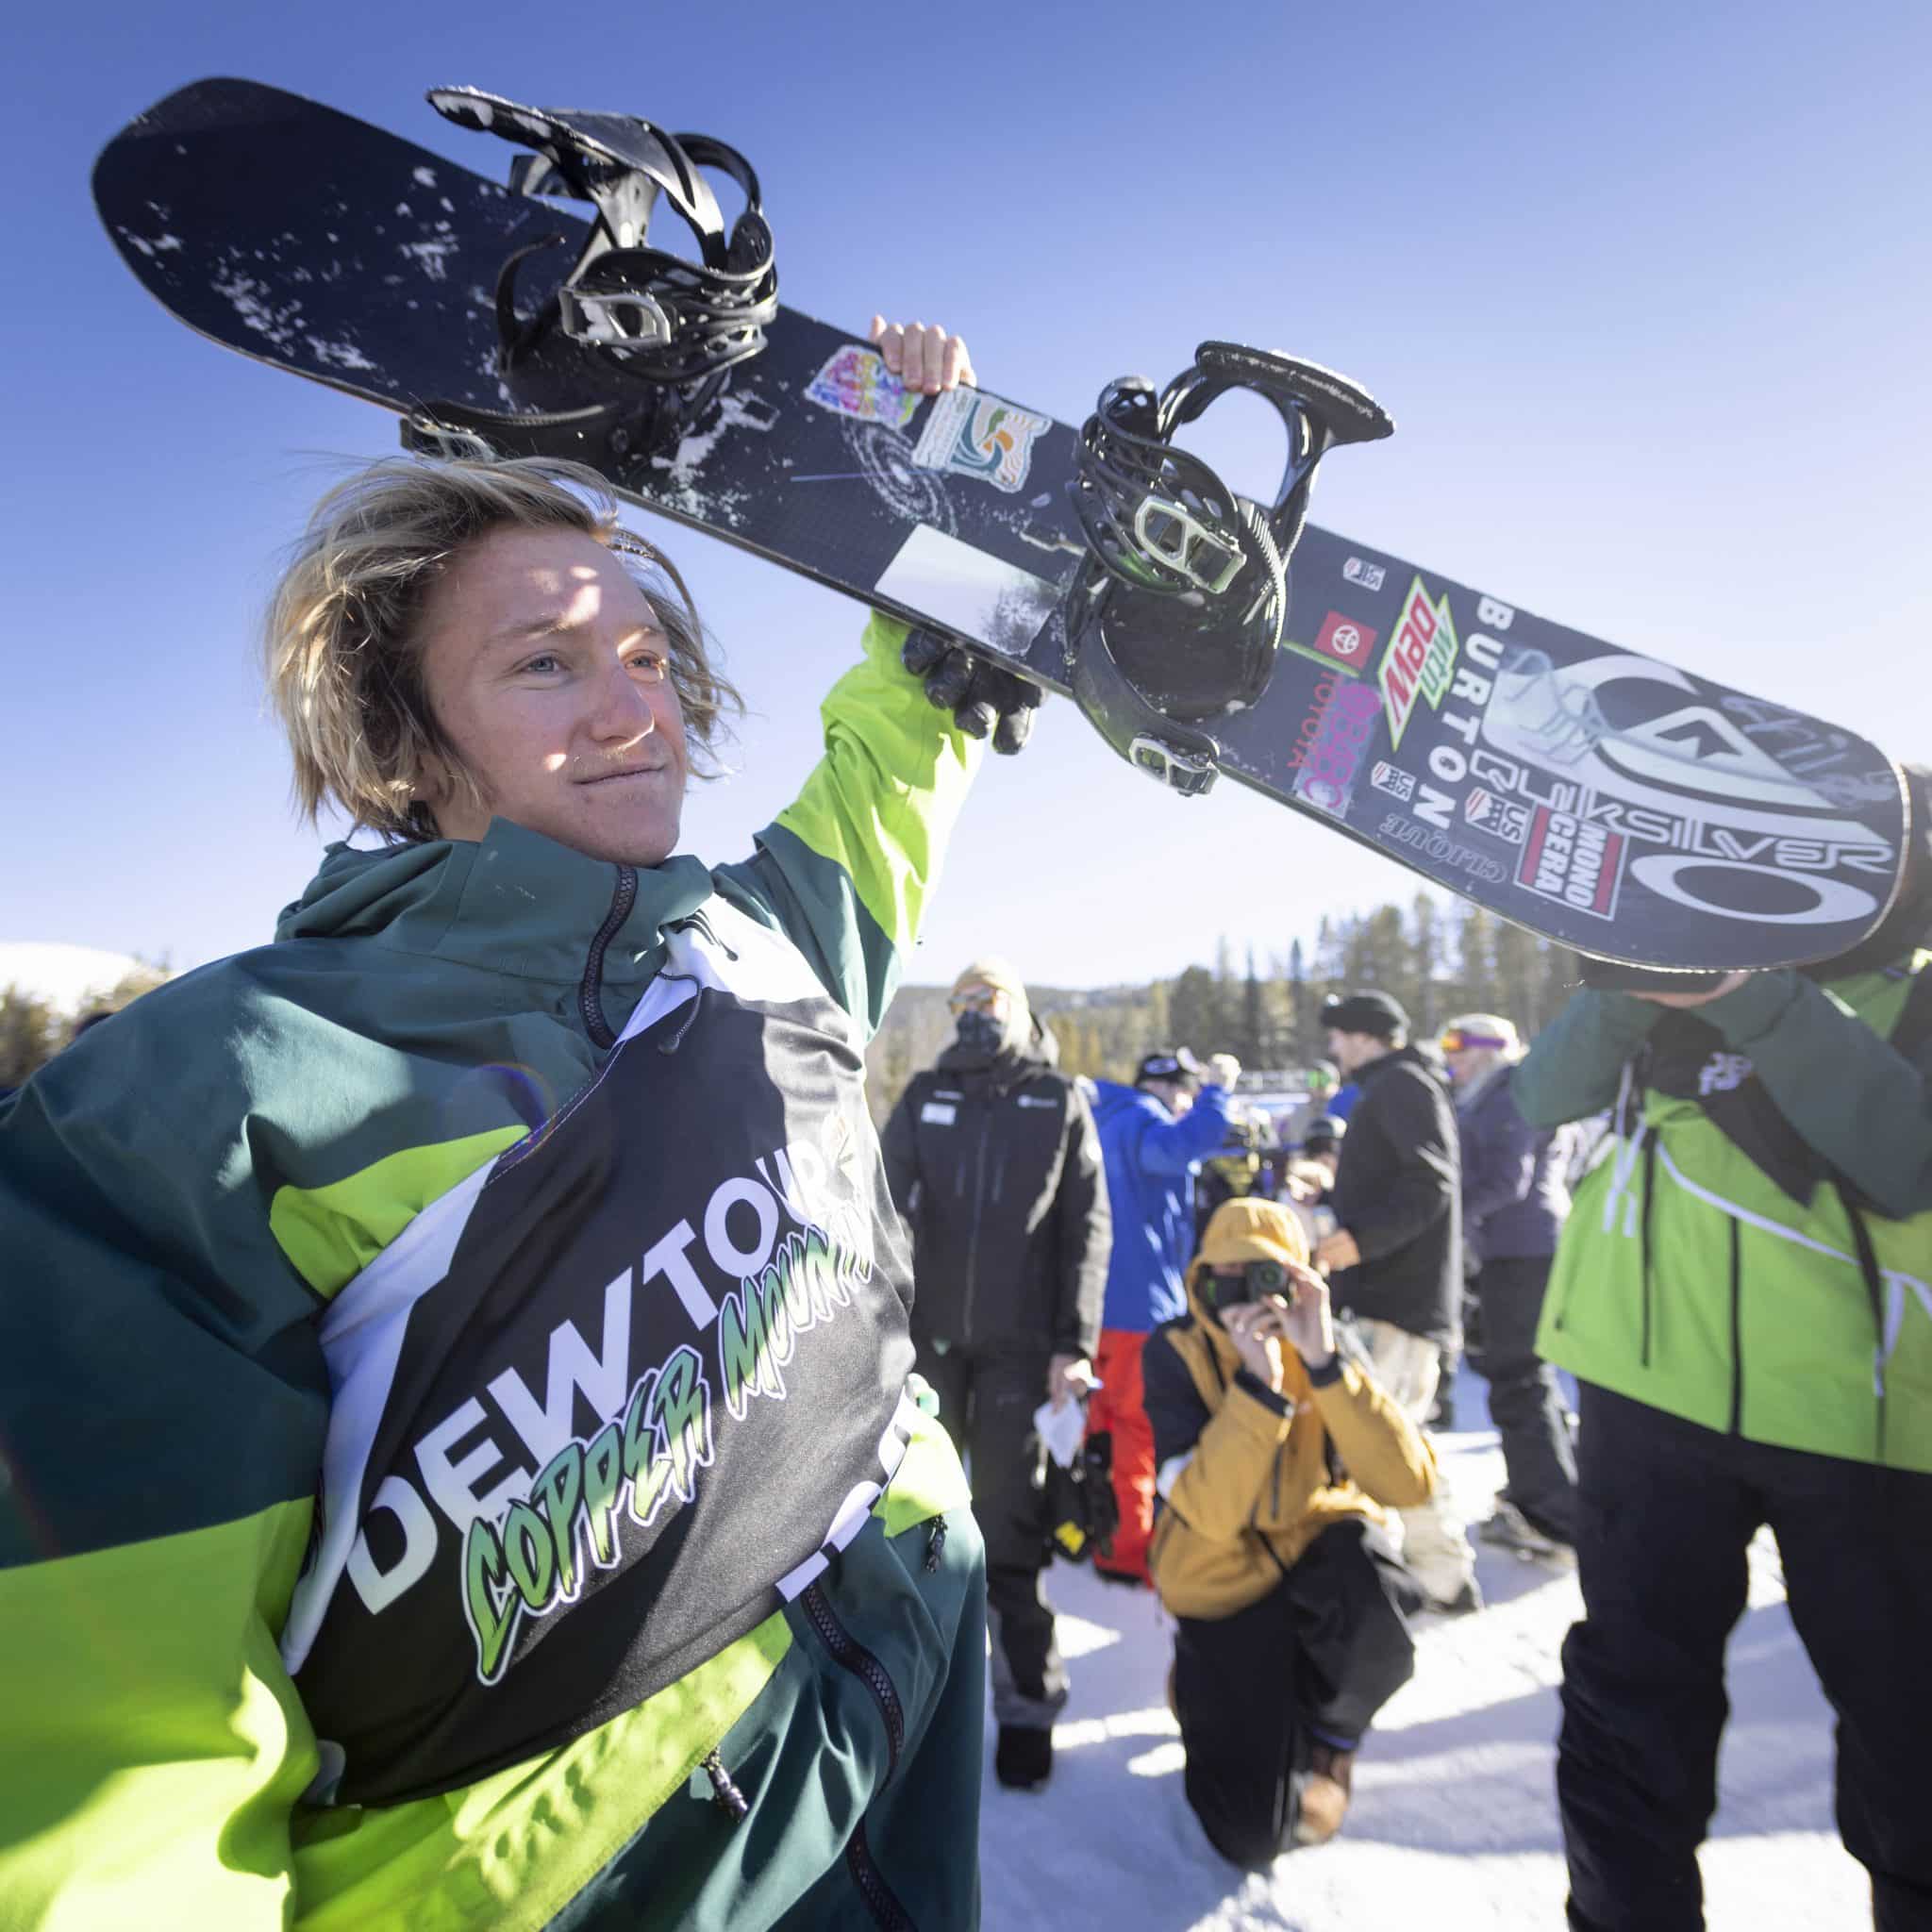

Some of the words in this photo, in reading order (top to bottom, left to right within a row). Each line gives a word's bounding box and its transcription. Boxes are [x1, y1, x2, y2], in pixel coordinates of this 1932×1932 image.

[1287, 672, 1341, 768] TOYOTA
[1412, 595, 1514, 830] BURTON
[1383, 812, 1508, 884] CLIQUE
[1534, 811, 1577, 893] CERA
[1566, 819, 1606, 908] MONO
[346, 1267, 632, 1615] DEW
[641, 1140, 841, 1331] TOUR
[460, 1344, 714, 1686] COPPER
